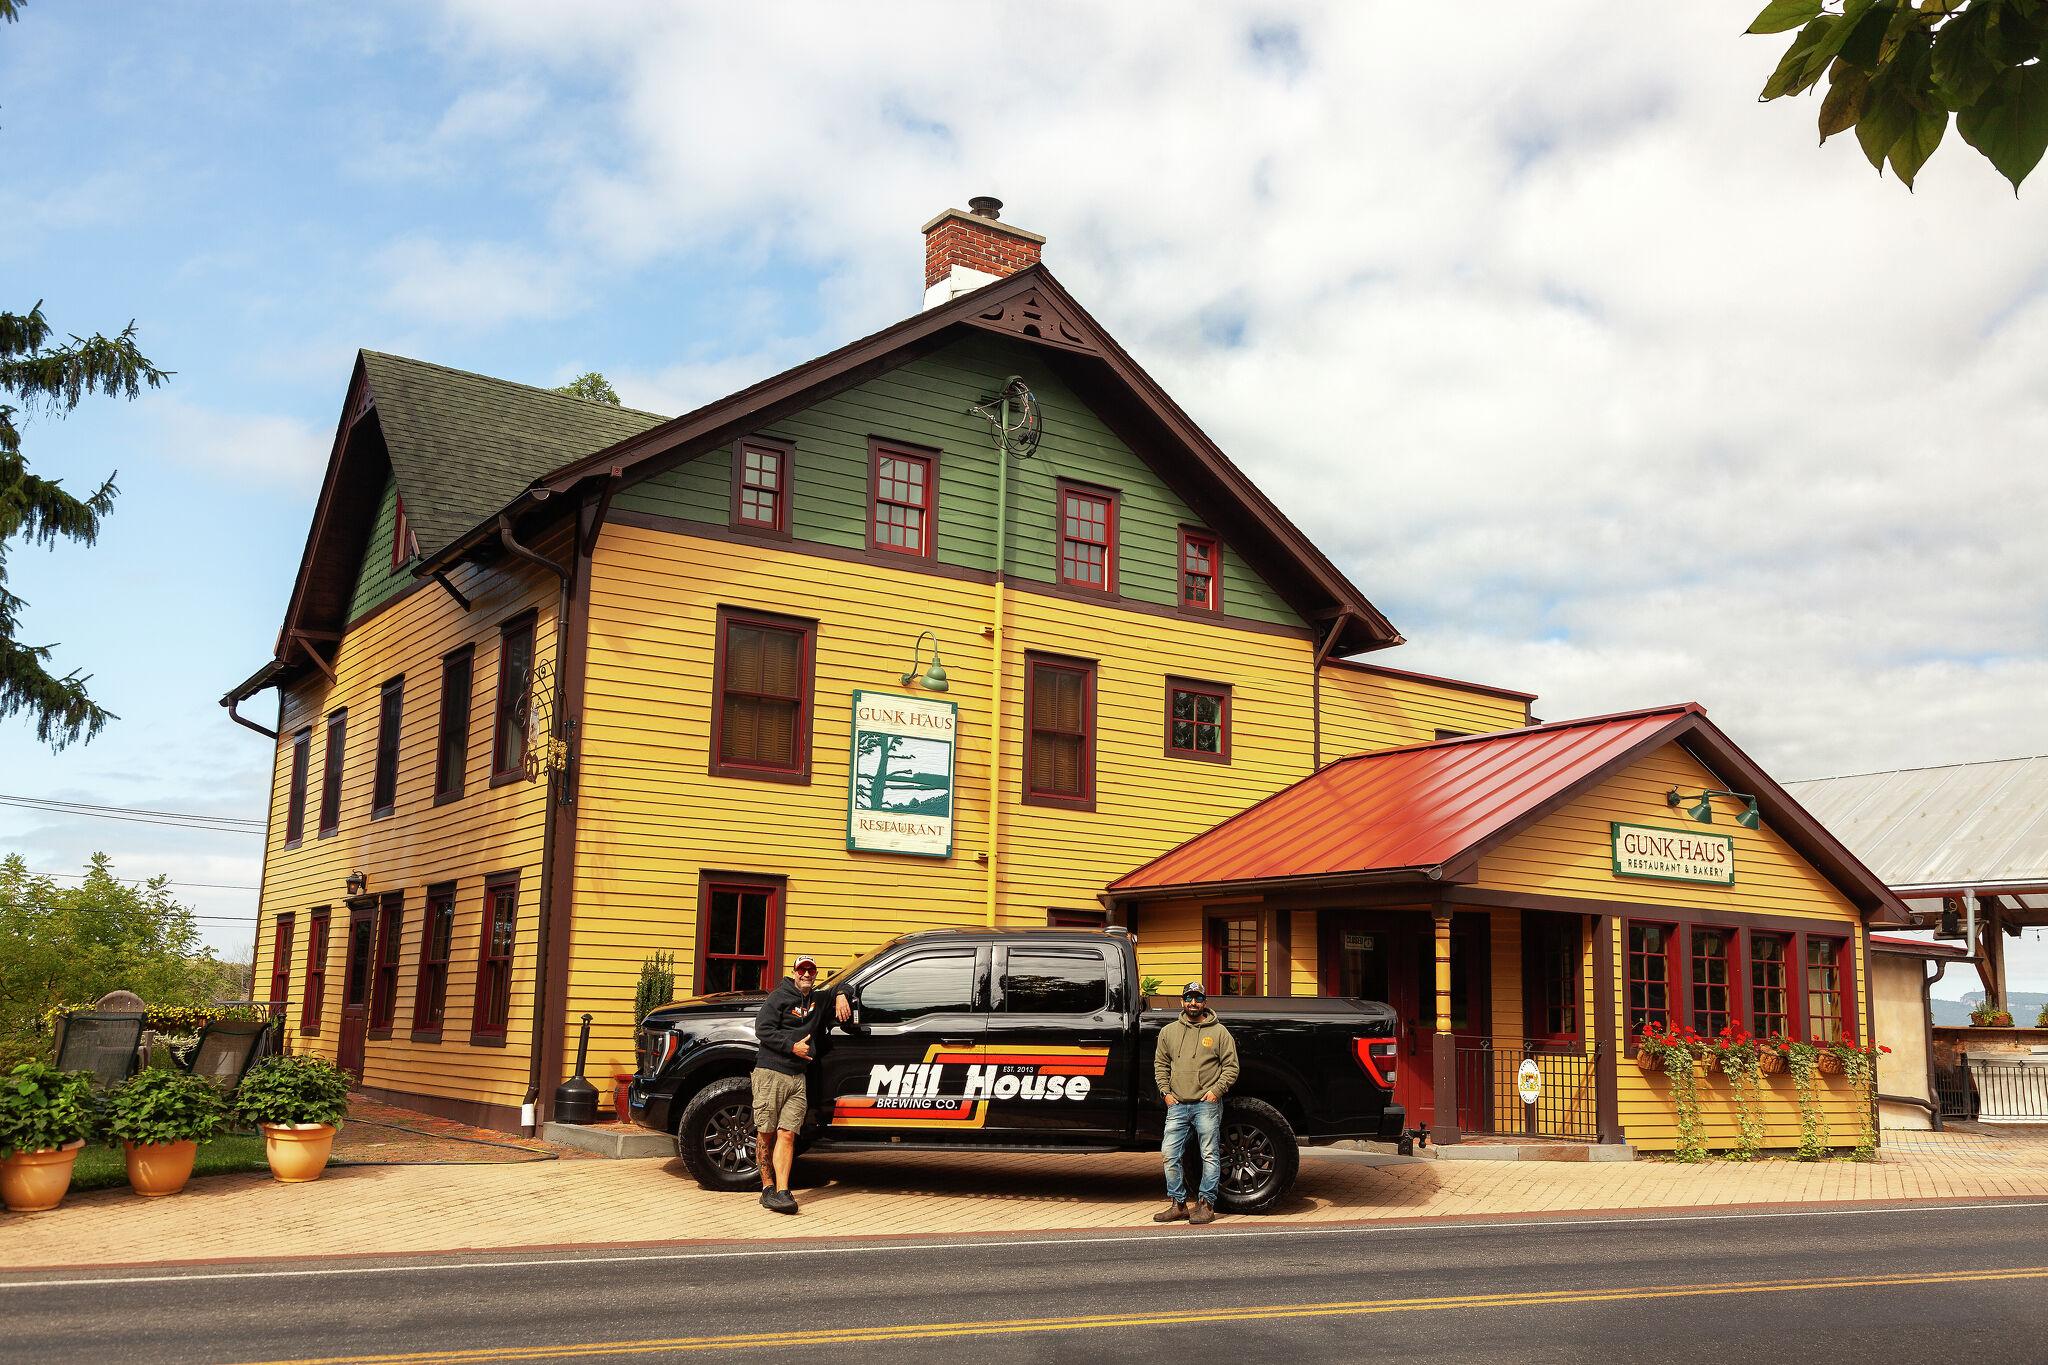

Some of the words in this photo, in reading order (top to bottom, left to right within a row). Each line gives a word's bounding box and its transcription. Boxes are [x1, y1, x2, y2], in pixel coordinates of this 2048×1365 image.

[859, 707, 907, 725] GUNK
[910, 712, 952, 730] HAUS
[859, 818, 945, 836] RESTAURANT
[1624, 833, 1678, 861] GUNK
[1679, 839, 1726, 863] HAUS
[1628, 859, 1681, 873] RESTAURANT
[1685, 864, 1689, 873] &
[1693, 865, 1724, 877] BAKERY
[866, 1064, 944, 1099] Mill
[962, 1064, 1091, 1101] House
[876, 1098, 931, 1109] BREWING
[936, 1098, 958, 1110] CO.
